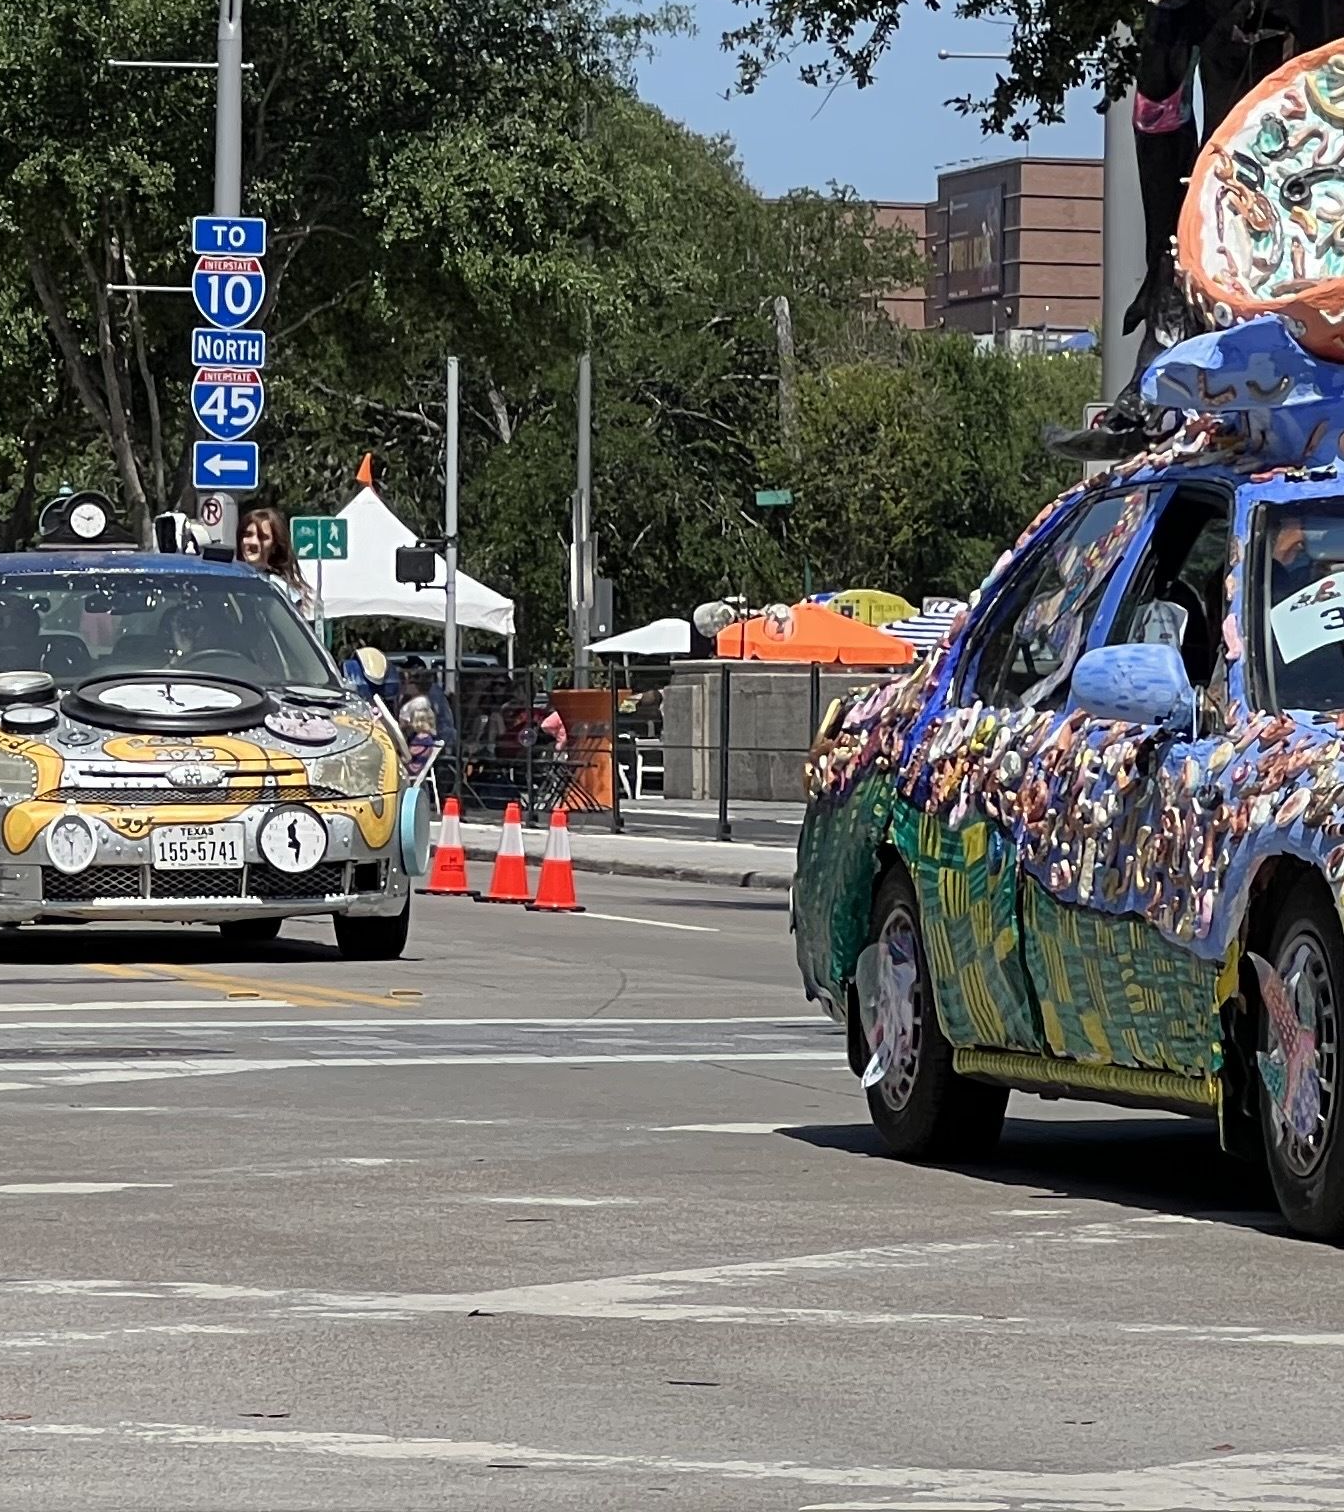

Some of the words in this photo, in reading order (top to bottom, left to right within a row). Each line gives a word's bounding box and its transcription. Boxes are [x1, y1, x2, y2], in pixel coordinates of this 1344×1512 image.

[212, 225, 246, 247] TO
[204, 261, 252, 271] INTERSTATE
[208, 275, 252, 315] 10
[197, 335, 260, 361] NORTH
[204, 373, 252, 381] INTERSTATE
[199, 386, 256, 426] 45
[154, 748, 216, 761] 2025
[180, 827, 214, 836] TEXAS
